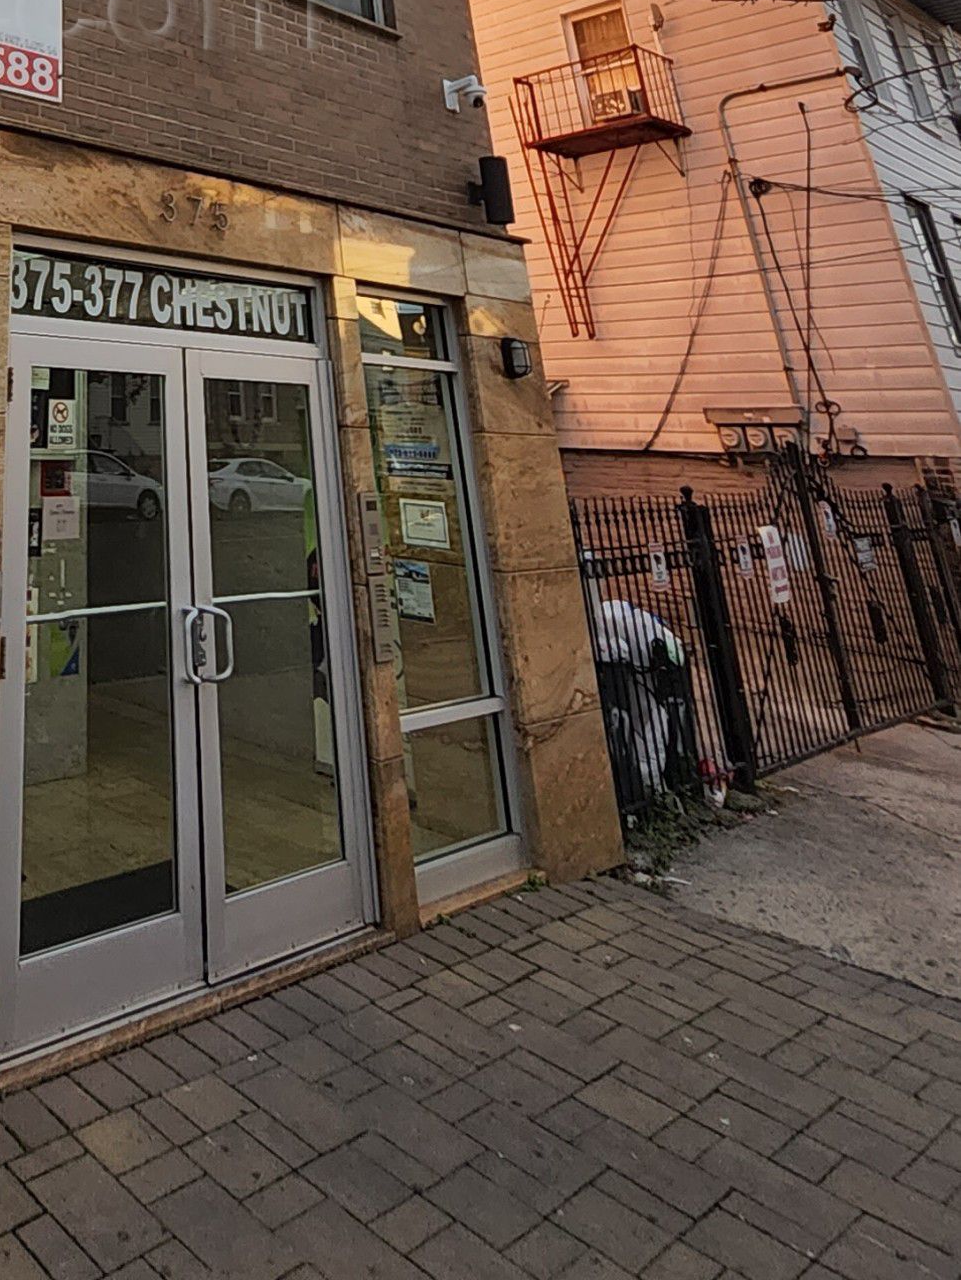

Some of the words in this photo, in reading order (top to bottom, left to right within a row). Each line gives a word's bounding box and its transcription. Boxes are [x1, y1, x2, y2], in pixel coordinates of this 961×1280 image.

[159, 193, 229, 231] 375
[11, 259, 142, 320] 375-377
[150, 273, 306, 337] CHESTNUT
